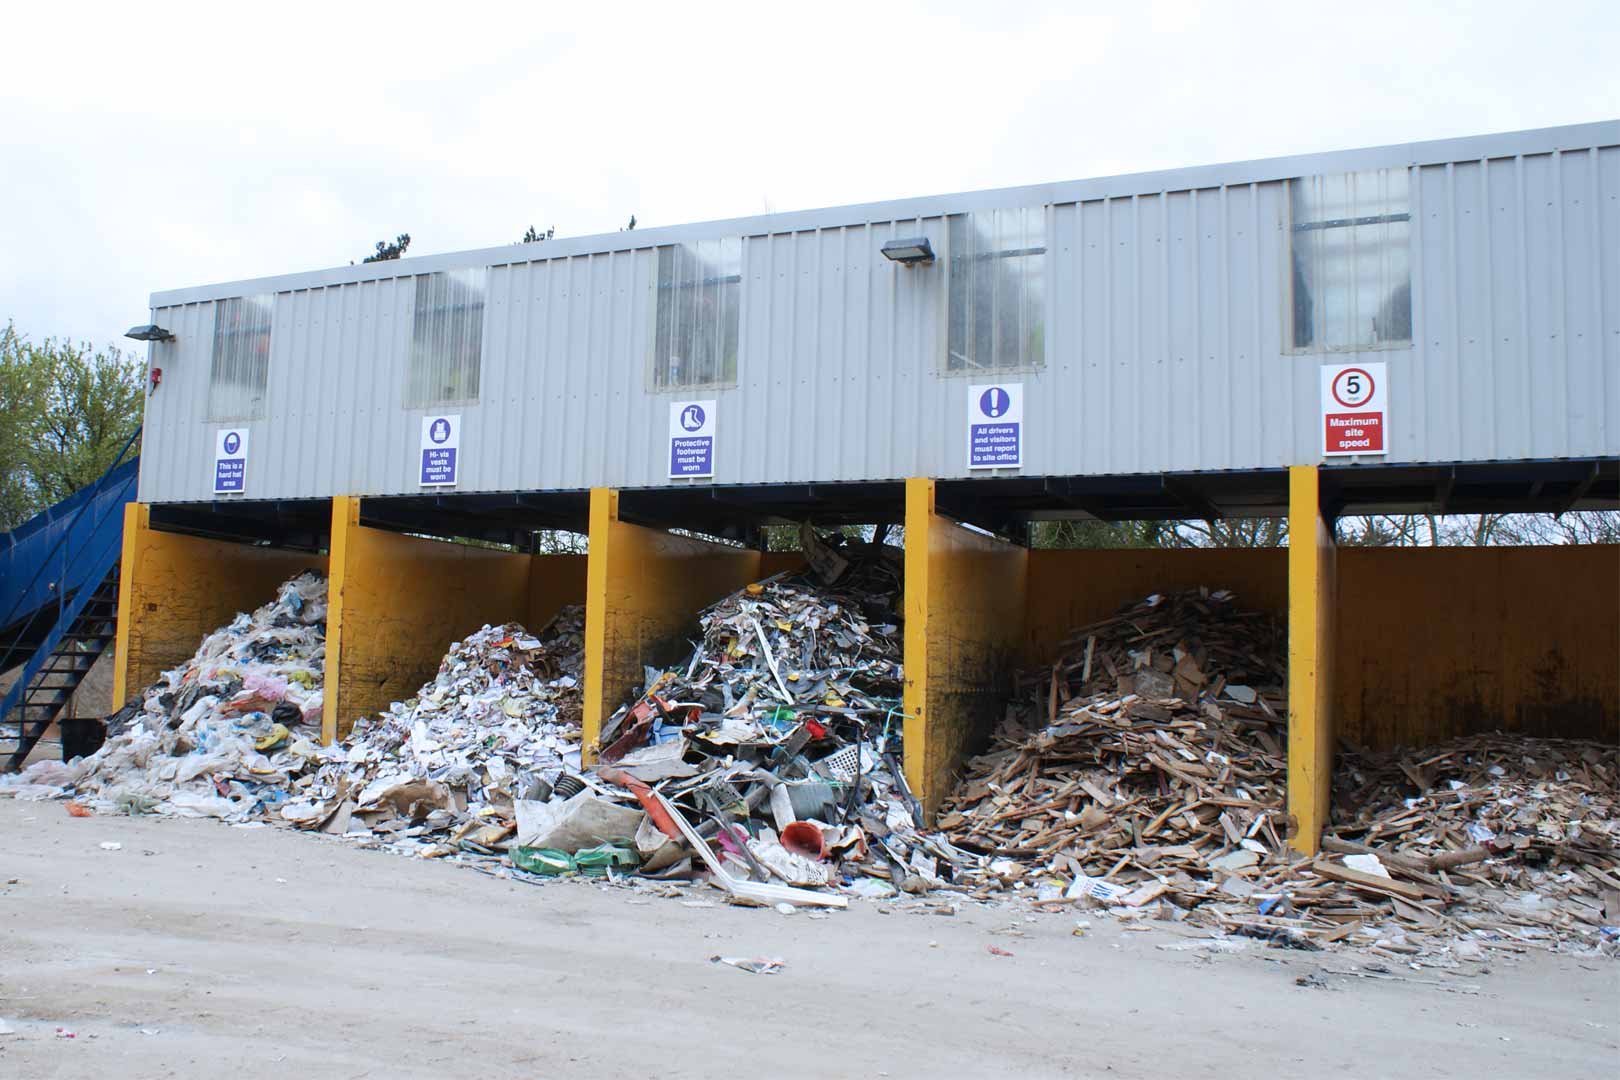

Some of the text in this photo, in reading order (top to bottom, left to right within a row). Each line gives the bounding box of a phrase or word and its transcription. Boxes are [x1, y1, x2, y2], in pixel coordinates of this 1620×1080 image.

[1347, 375, 1360, 394] 5
[1330, 418, 1378, 427] Maximum
[1345, 428, 1364, 437] site
[1339, 438, 1370, 449] speed
[994, 445, 1017, 453] report
[996, 453, 1017, 461] office
